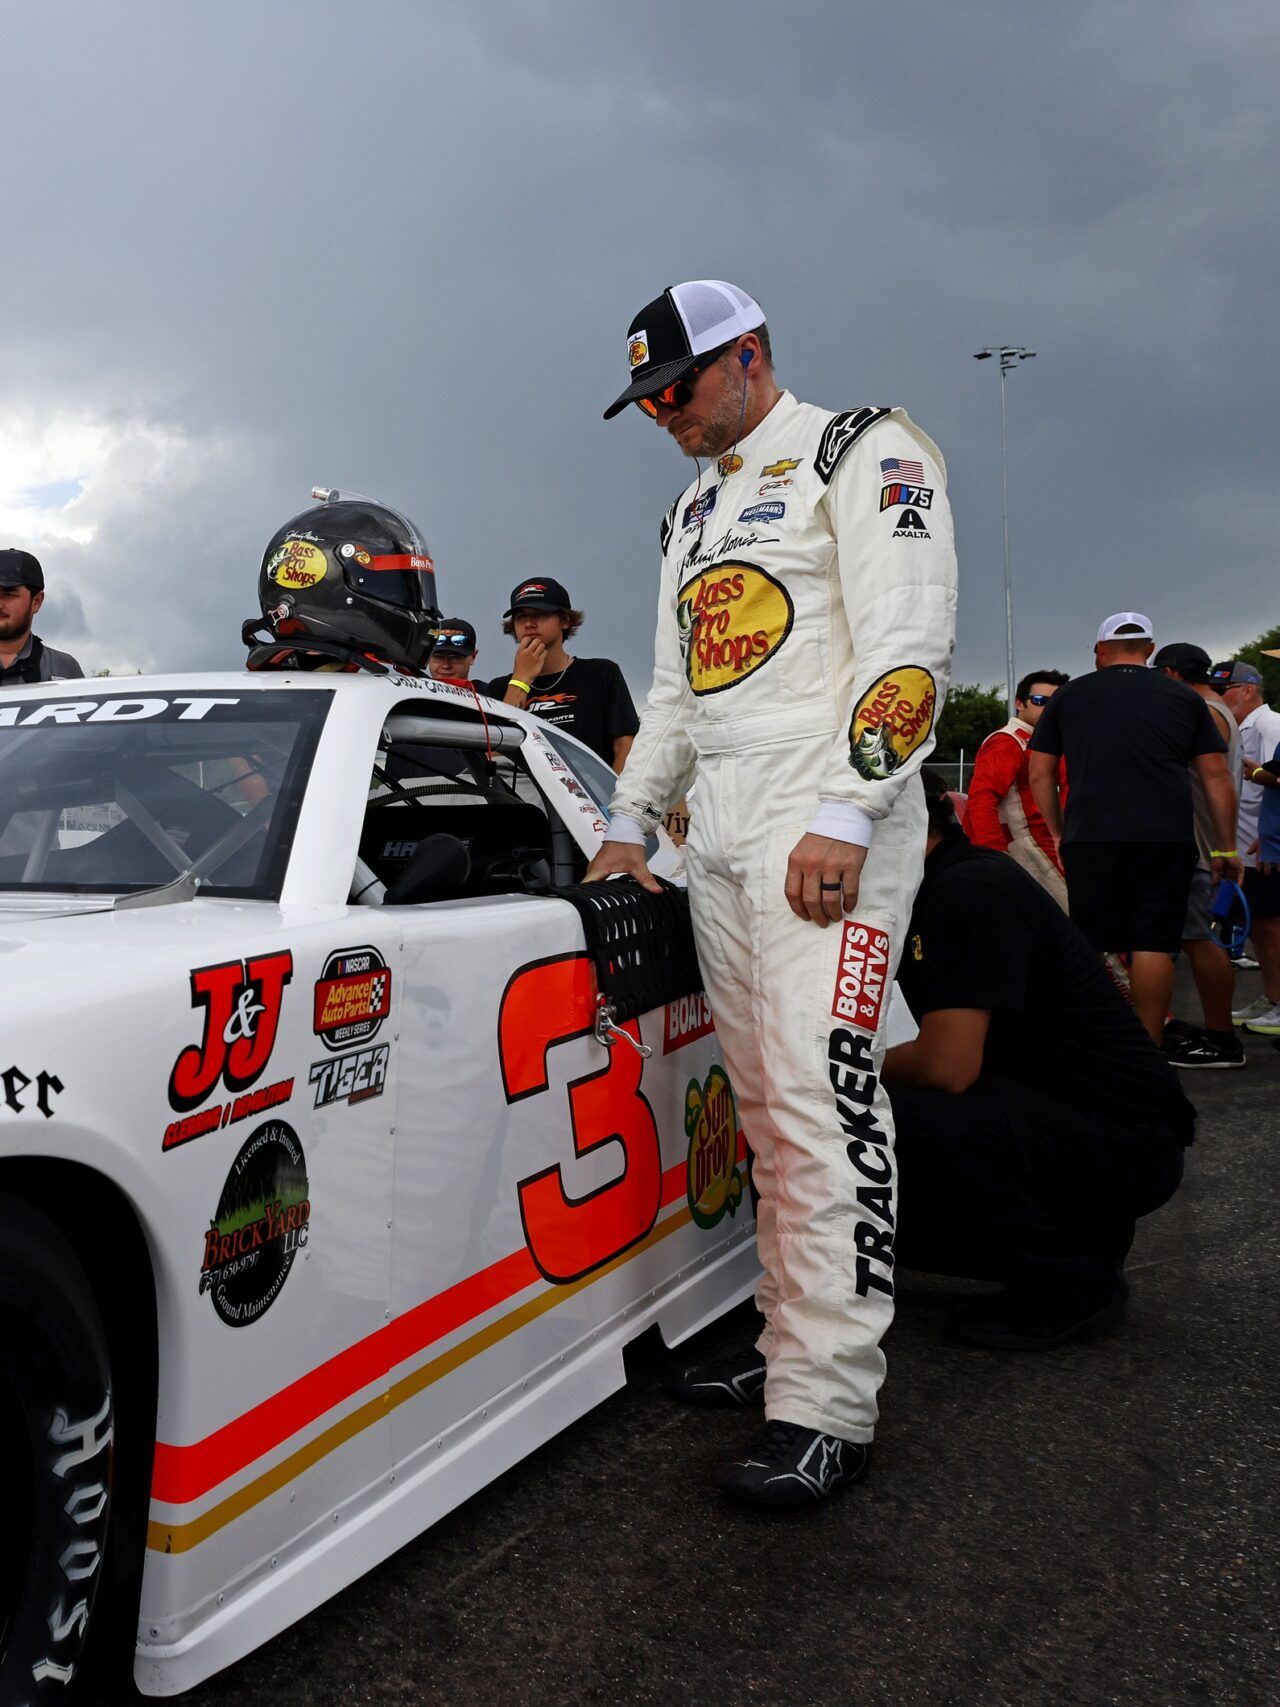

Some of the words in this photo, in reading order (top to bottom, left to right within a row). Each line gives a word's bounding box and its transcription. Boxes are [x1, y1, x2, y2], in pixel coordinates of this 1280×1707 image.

[908, 487, 931, 507] 75
[288, 542, 316, 558] Bass
[892, 530, 932, 539] AXALTA
[283, 567, 317, 586] Shops
[285, 555, 306, 569] Pro
[410, 557, 425, 567] Bass
[697, 630, 769, 674] Shops
[857, 681, 901, 728] Bass
[882, 700, 913, 735] Pro
[898, 690, 934, 746] Shops
[345, 956, 370, 973] NASCAR
[835, 925, 869, 1019] BOATS
[320, 1005, 344, 1024] Auto
[344, 1001, 368, 1020] Parts
[326, 982, 369, 1005] Advance
[168, 948, 294, 1113] J&J
[334, 1023, 354, 1040] WEEKLY
[353, 1021, 371, 1036] SERIES
[670, 991, 713, 1041] BOATS
[309, 1046, 389, 1107] TIGER
[498, 950, 662, 1285] 3
[699, 1083, 730, 1147] Sun
[234, 1127, 269, 1175] Licensed
[269, 1126, 278, 1142] &
[279, 1127, 300, 1166] Insured
[694, 1126, 730, 1203] Drop
[829, 1027, 896, 1299] TRACKER
[283, 1224, 310, 1254] LLC
[223, 1251, 260, 1280] 650-9797
[216, 1284, 242, 1319] Ground
[242, 1256, 290, 1319] Maintenance
